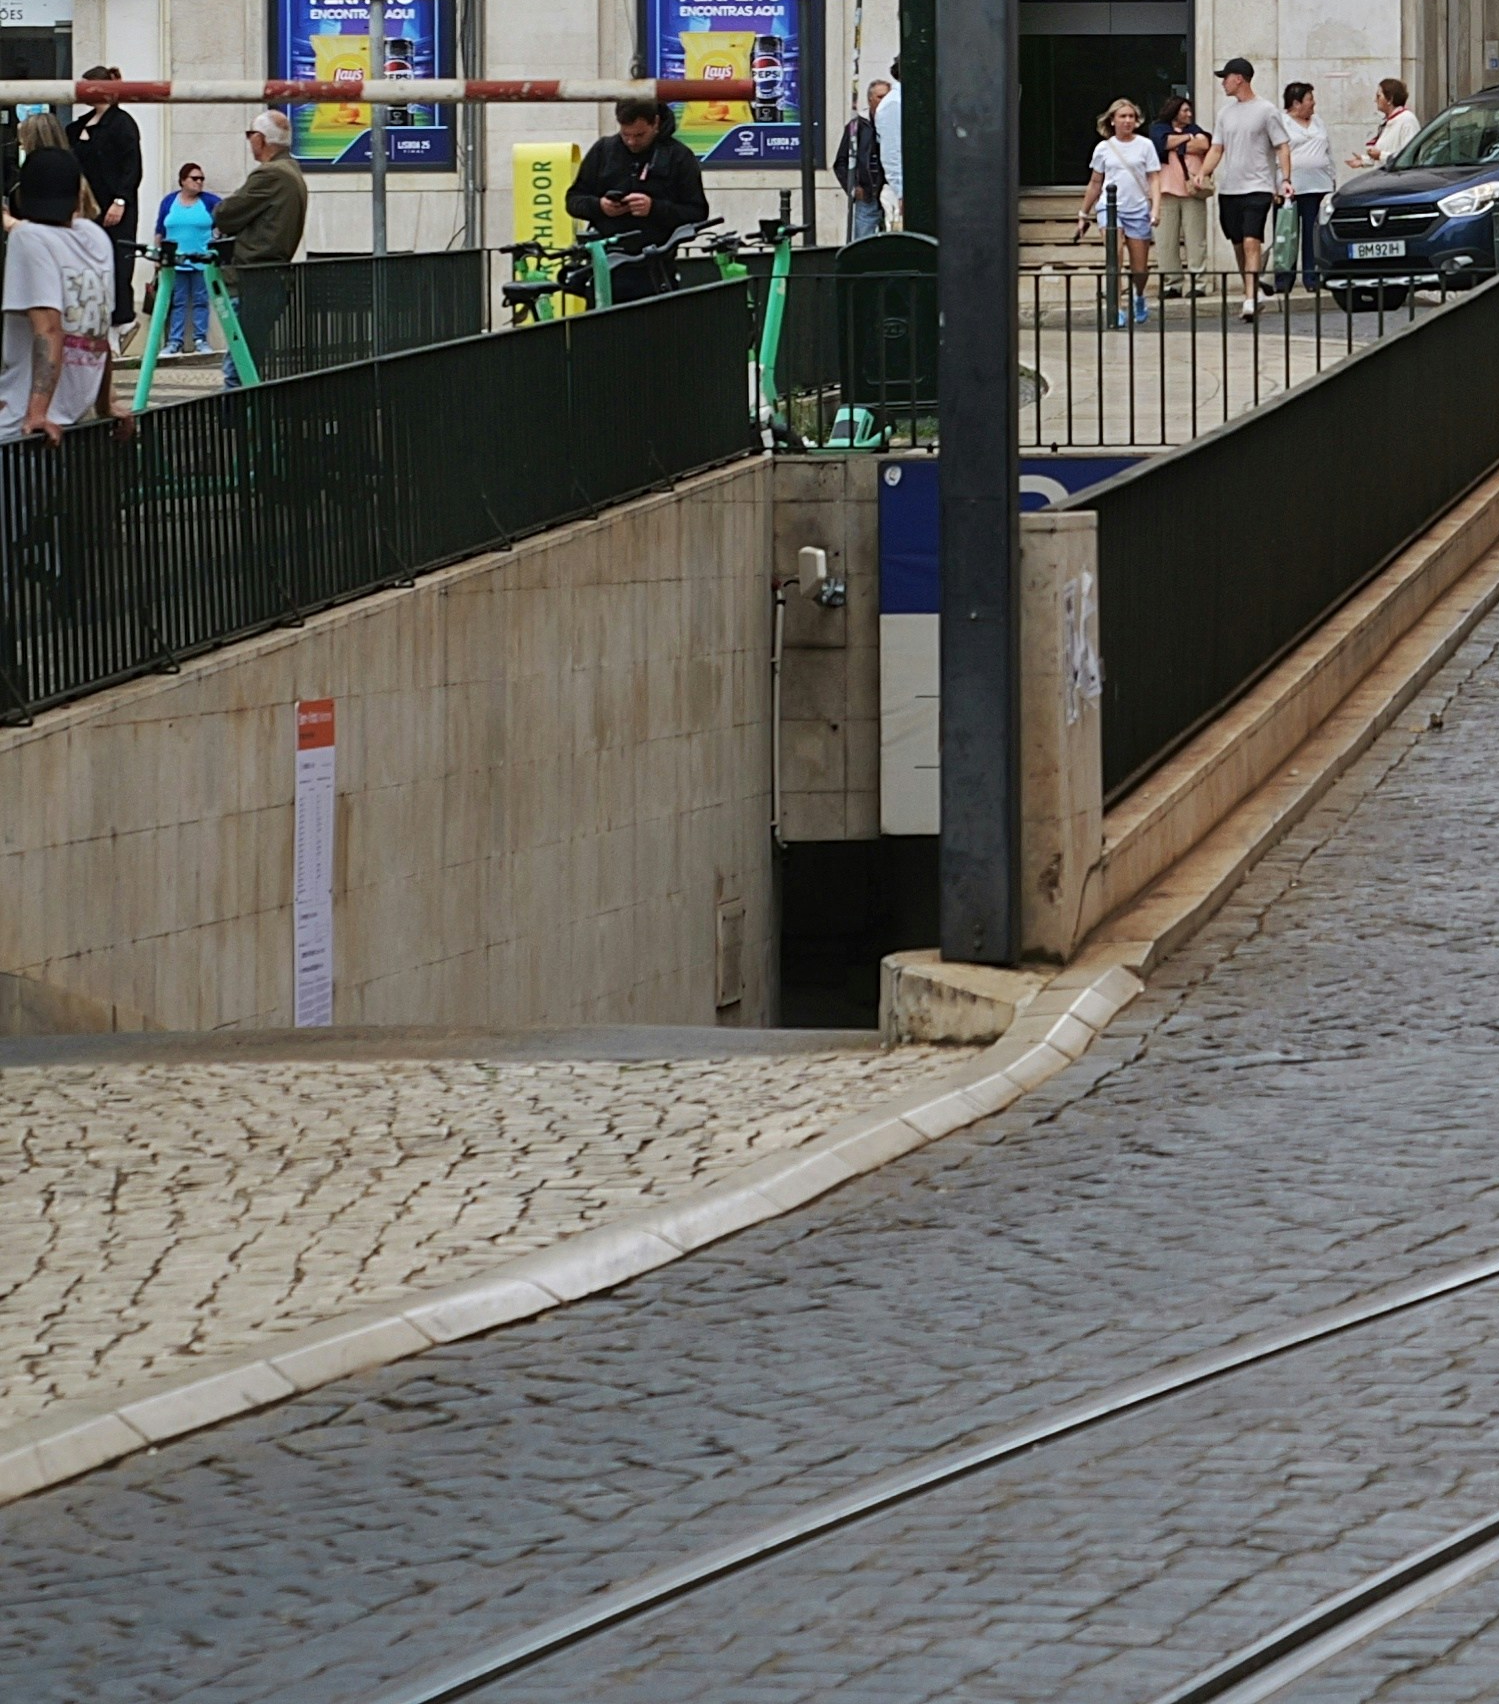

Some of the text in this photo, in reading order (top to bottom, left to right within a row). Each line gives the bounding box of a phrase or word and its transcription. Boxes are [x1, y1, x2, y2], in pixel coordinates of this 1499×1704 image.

[384, 8, 416, 20] AQUI
[680, 5, 785, 17] ENCONTRAS AQUI
